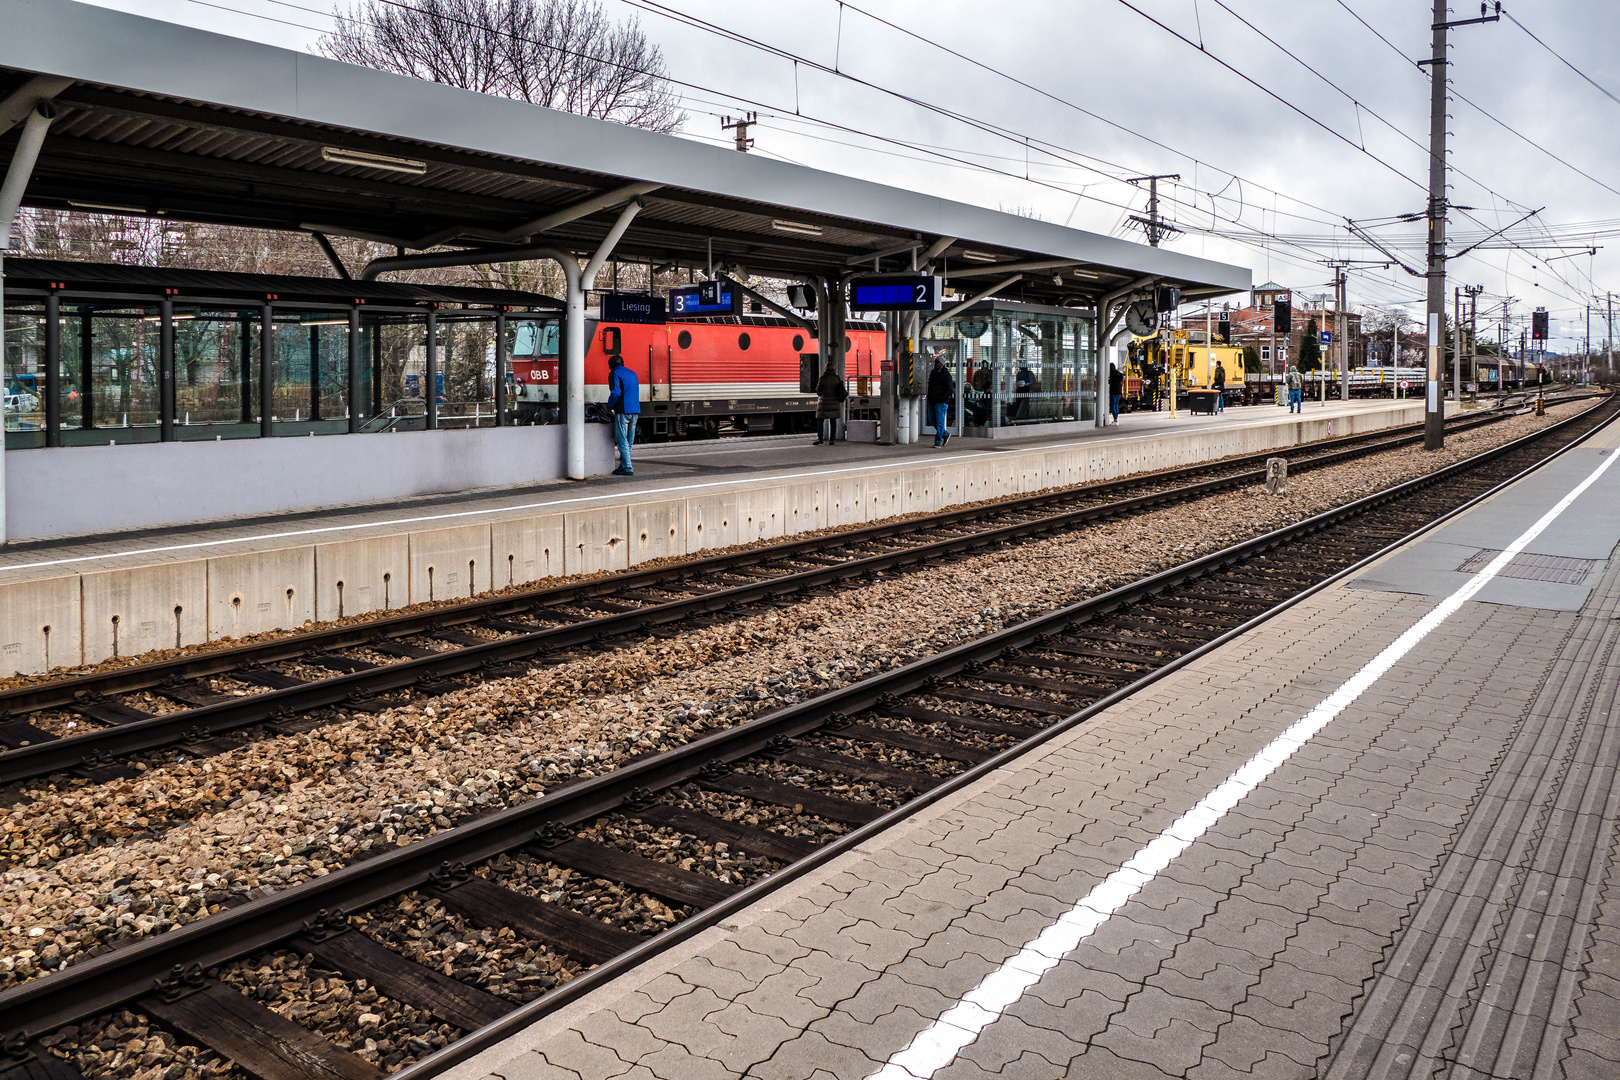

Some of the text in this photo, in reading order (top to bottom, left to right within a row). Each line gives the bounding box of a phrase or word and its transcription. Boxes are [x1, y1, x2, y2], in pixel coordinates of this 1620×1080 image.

[916, 285, 927, 302] 2
[621, 301, 651, 314] Liesing
[676, 296, 684, 311] 3
[1222, 312, 1227, 320] S
[1271, 476, 1279, 488] 7
